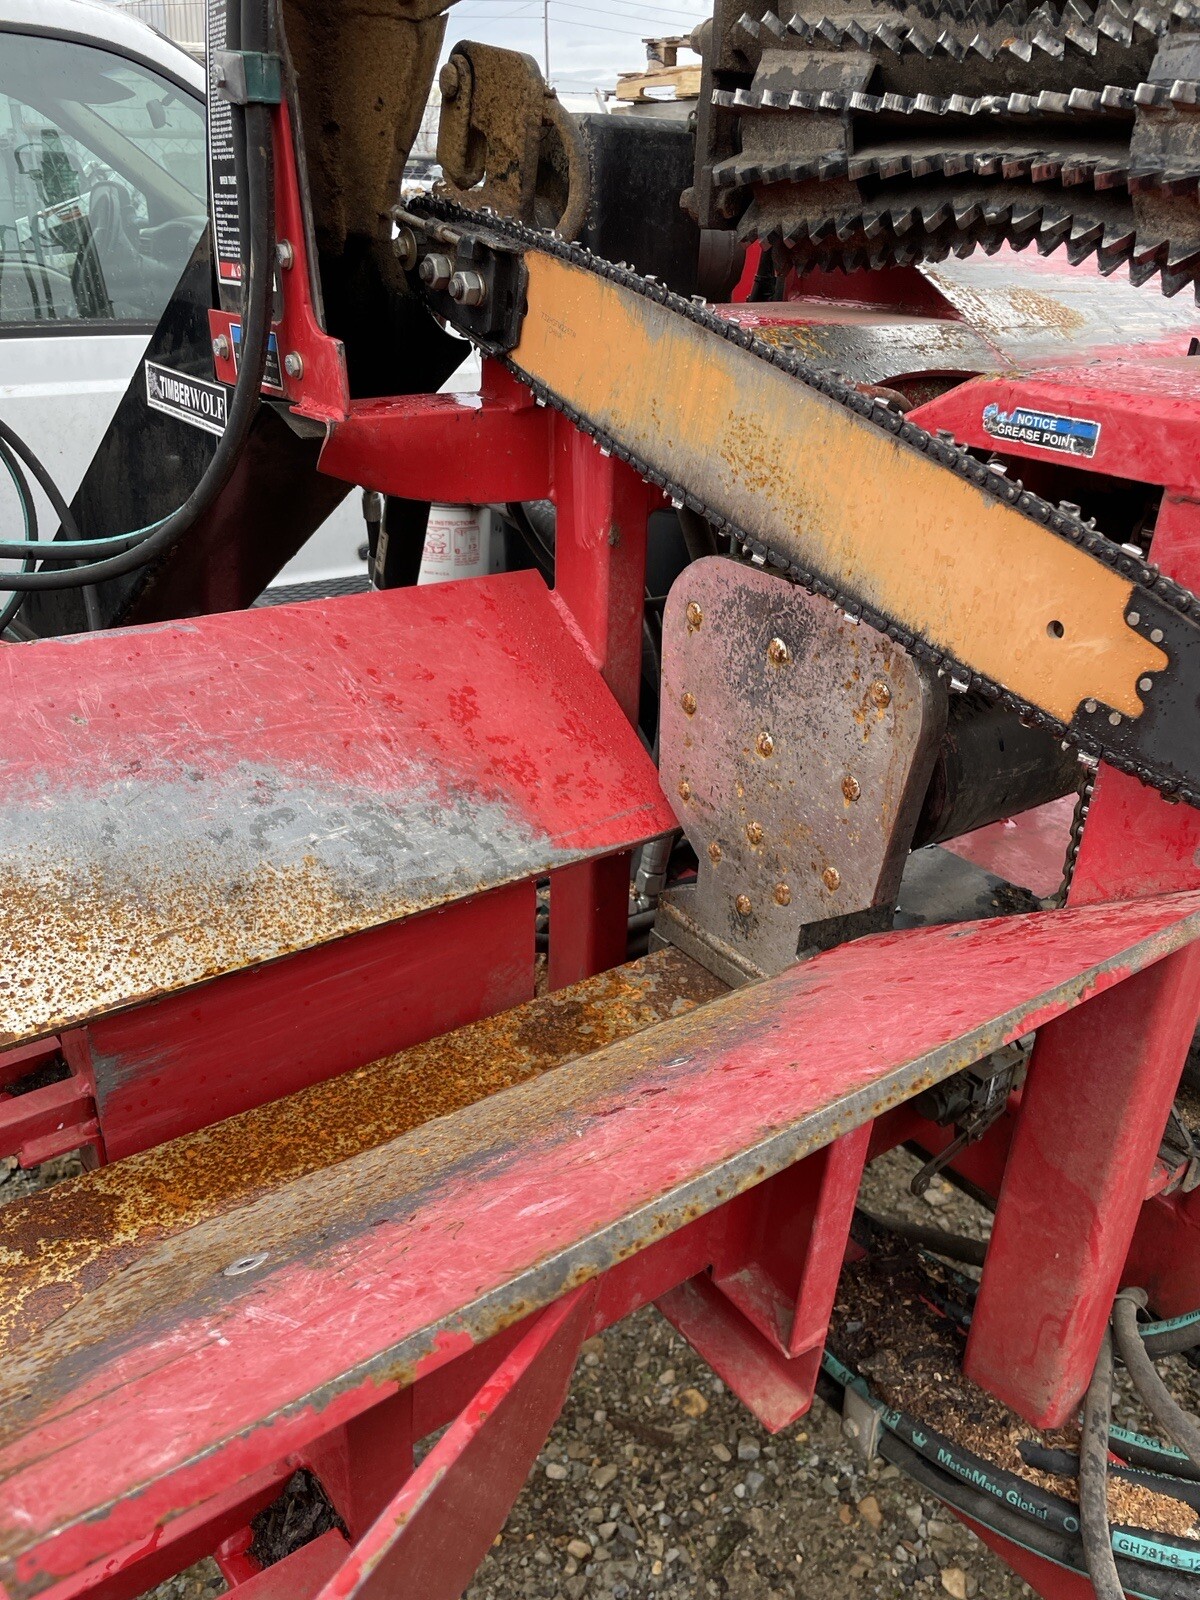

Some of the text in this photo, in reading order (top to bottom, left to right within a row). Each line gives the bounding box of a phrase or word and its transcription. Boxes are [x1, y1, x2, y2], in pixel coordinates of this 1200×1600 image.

[159, 375, 225, 420] TIMBERWOLF
[997, 423, 1077, 453] GREASE POINT
[1016, 413, 1058, 431] NOTICE
[937, 1448, 1047, 1520] MatchMate Global
